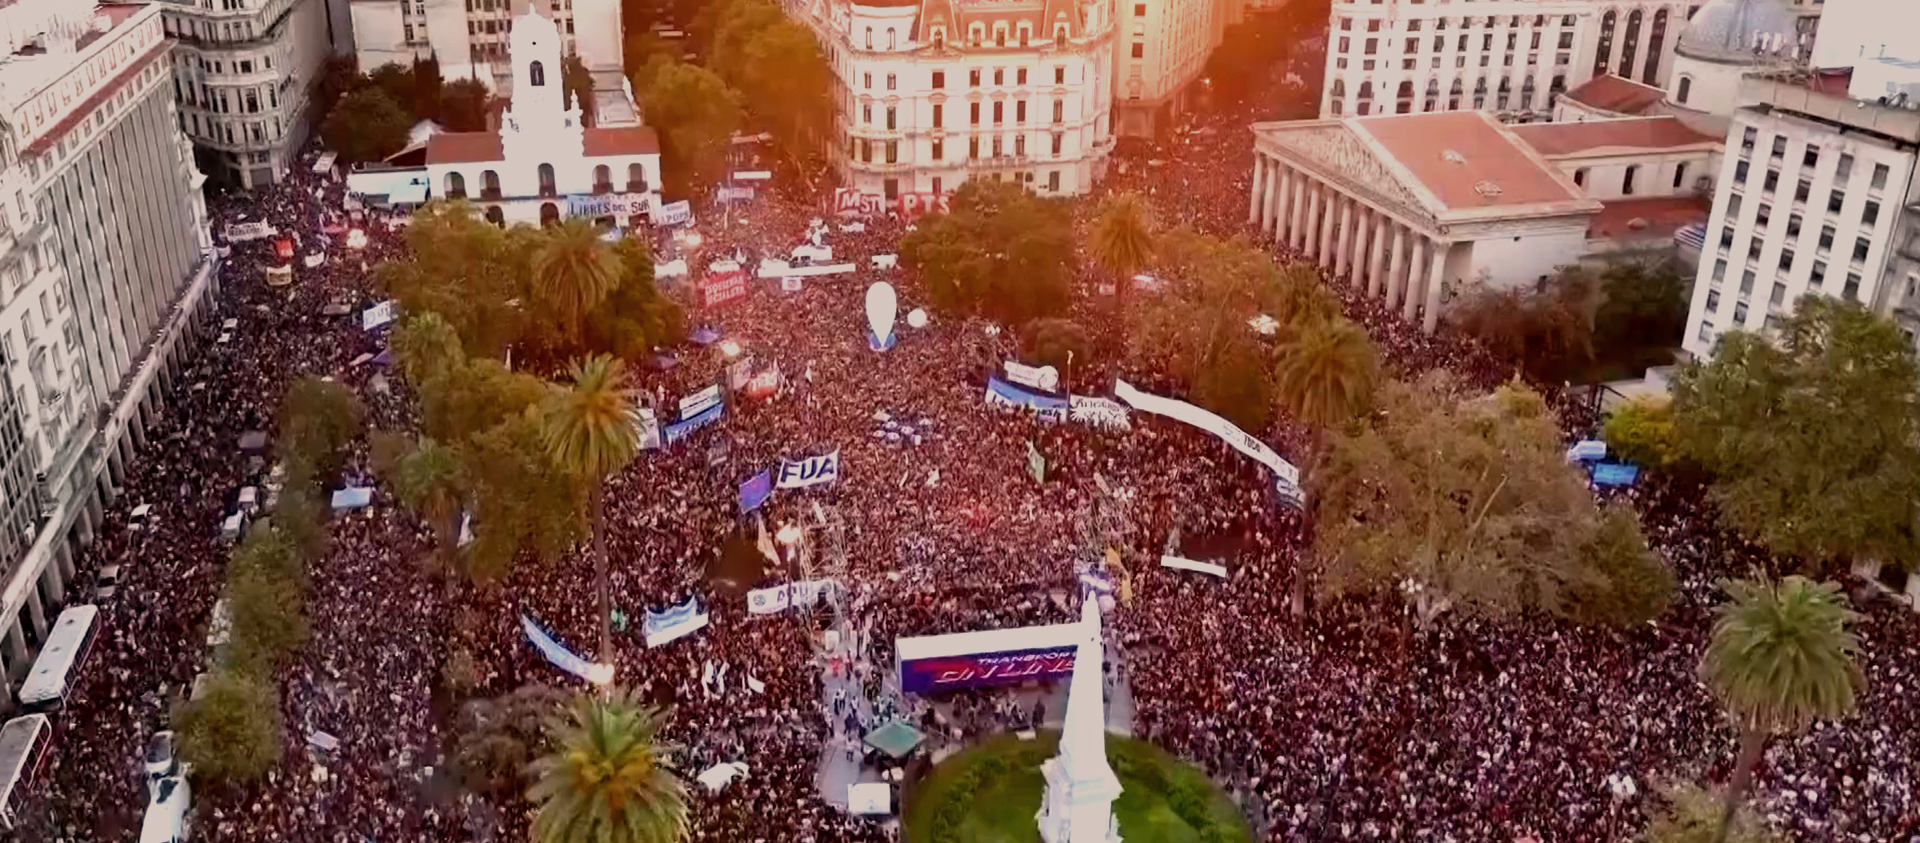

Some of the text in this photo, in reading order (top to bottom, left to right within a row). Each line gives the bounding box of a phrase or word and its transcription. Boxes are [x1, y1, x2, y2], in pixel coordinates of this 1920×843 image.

[841, 191, 882, 213] MST
[904, 194, 950, 215] PTS
[780, 457, 834, 483] FUA
